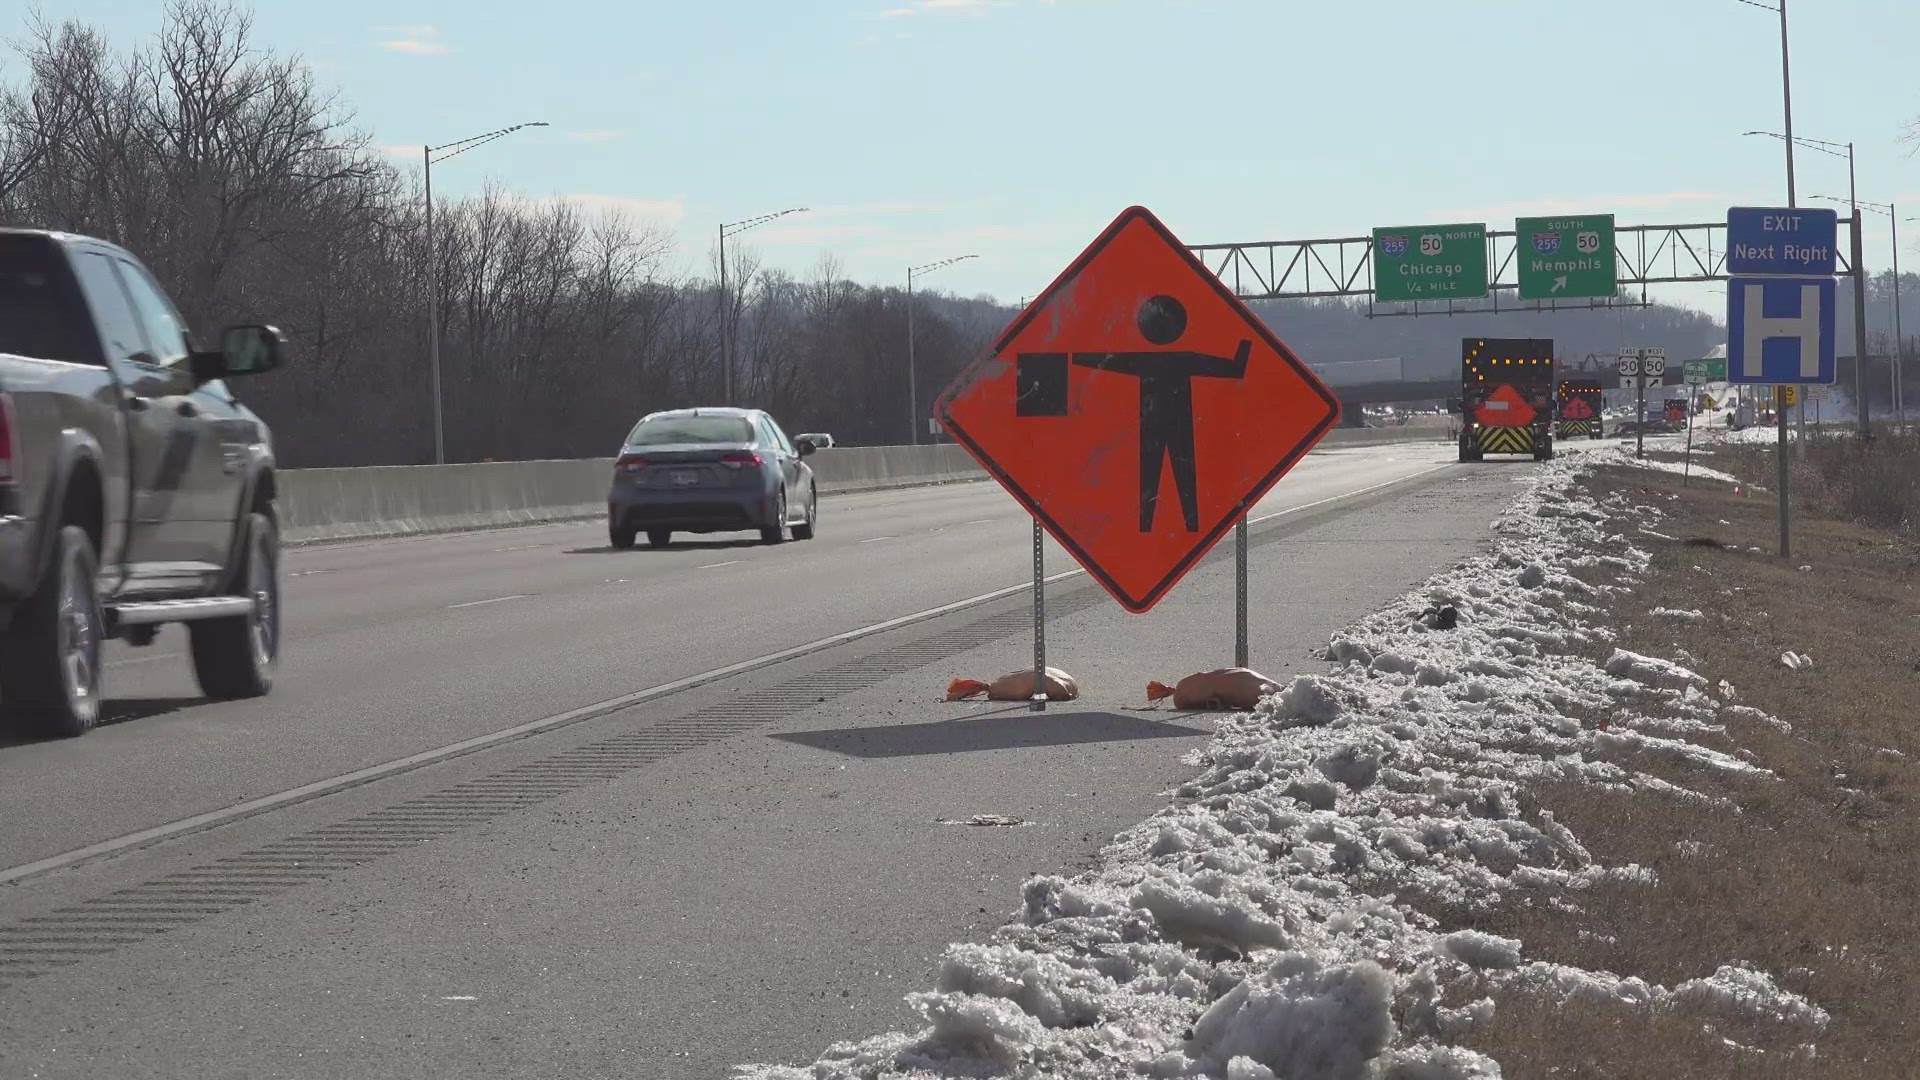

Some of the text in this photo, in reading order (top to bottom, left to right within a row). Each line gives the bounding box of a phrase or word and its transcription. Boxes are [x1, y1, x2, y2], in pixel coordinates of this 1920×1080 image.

[1547, 221, 1584, 230] SOUTH
[1763, 216, 1801, 231] EXIT
[1385, 231, 1480, 253] 255 50 NORTH
[1537, 235, 1598, 250] 255 50
[1735, 243, 1828, 265] Next Right
[1399, 263, 1462, 277] Chicago
[1531, 258, 1601, 272] Memphis
[1430, 282, 1457, 291] MILE
[1743, 284, 1821, 378] H
[1620, 360, 1637, 372] 50
[1646, 360, 1663, 372] 50
